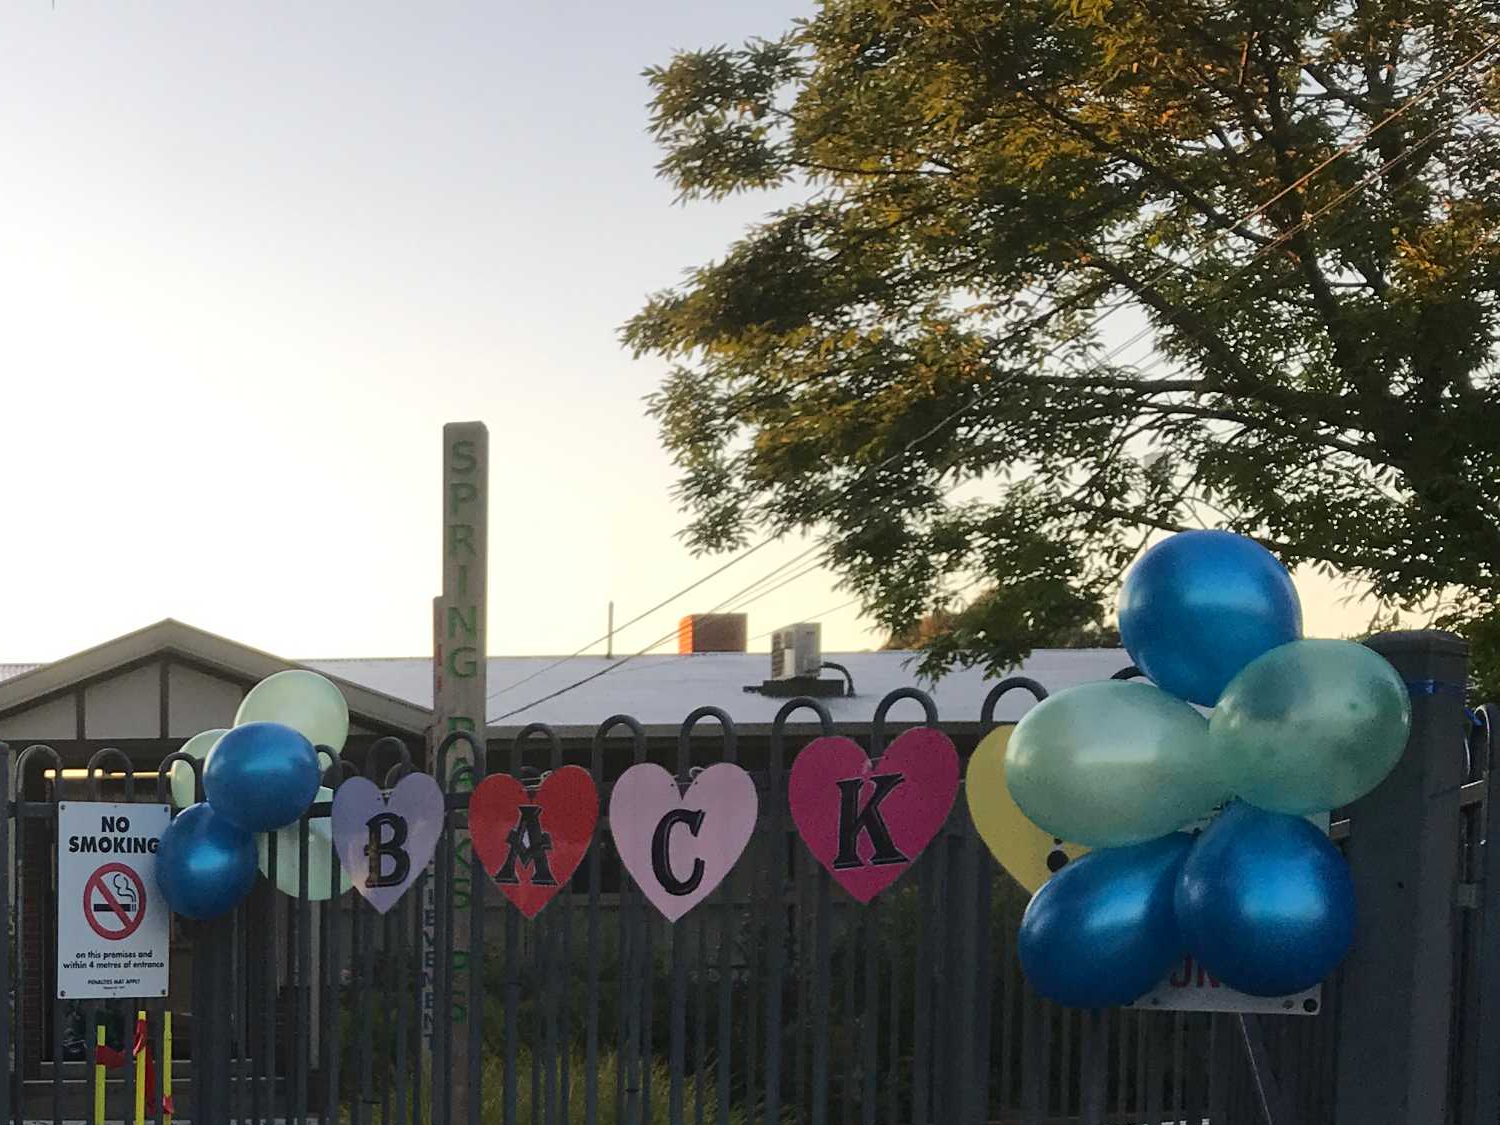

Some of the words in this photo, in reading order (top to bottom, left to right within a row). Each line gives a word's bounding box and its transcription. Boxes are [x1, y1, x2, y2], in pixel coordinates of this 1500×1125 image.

[447, 440, 478, 678] SPRING
[101, 816, 130, 833] NO
[447, 715, 477, 918] PAKS
[69, 836, 160, 854] SMOKING
[88, 950, 101, 958] this
[103, 951, 136, 960] premises
[138, 950, 153, 958] and
[63, 961, 87, 969] within
